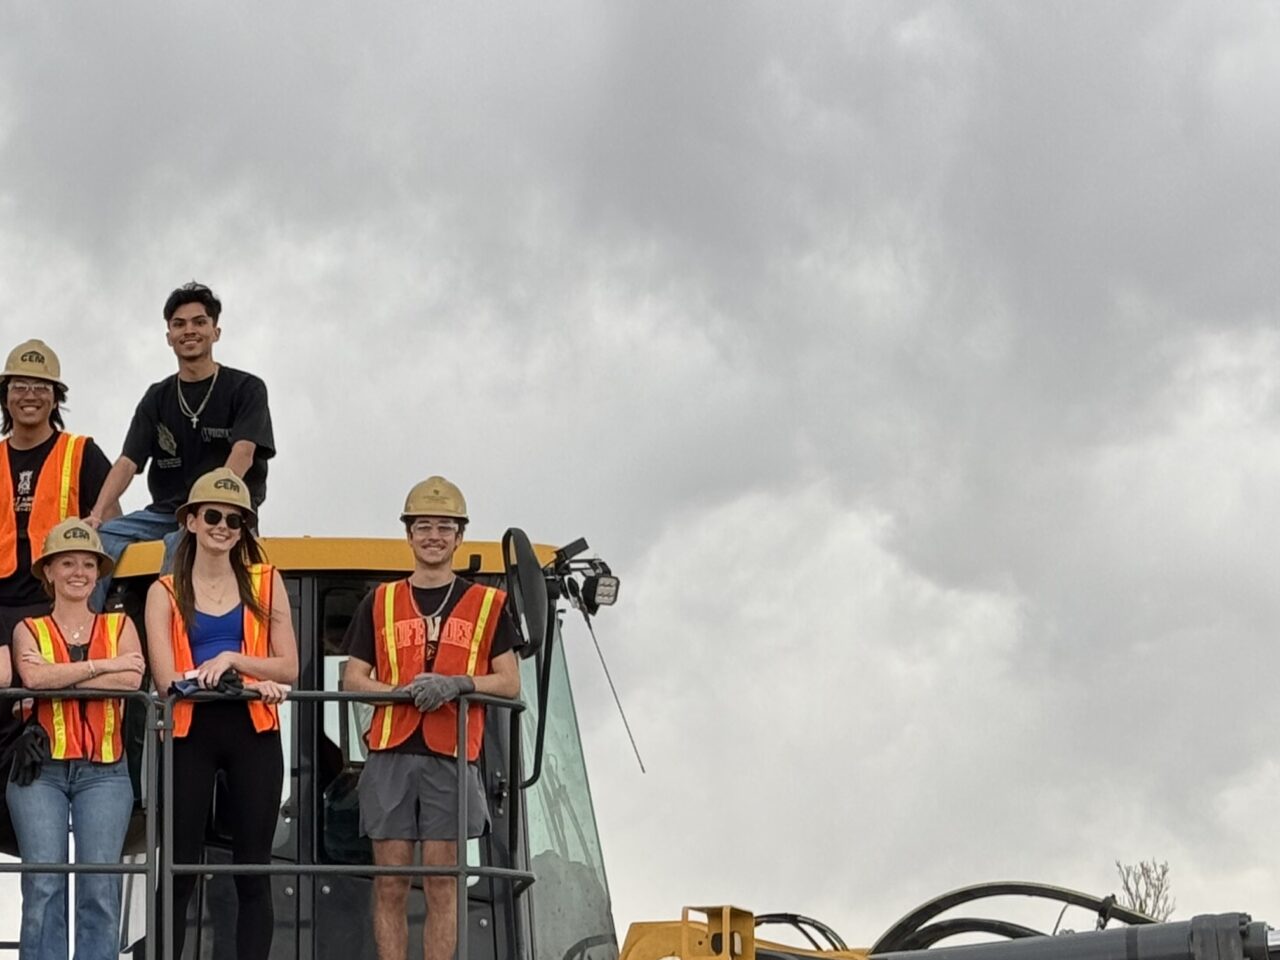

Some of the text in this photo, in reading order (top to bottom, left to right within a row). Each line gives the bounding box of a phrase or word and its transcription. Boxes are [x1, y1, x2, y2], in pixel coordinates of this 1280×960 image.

[21, 352, 46, 365] CEM
[214, 479, 240, 493] CEM
[63, 528, 90, 540] CEM
